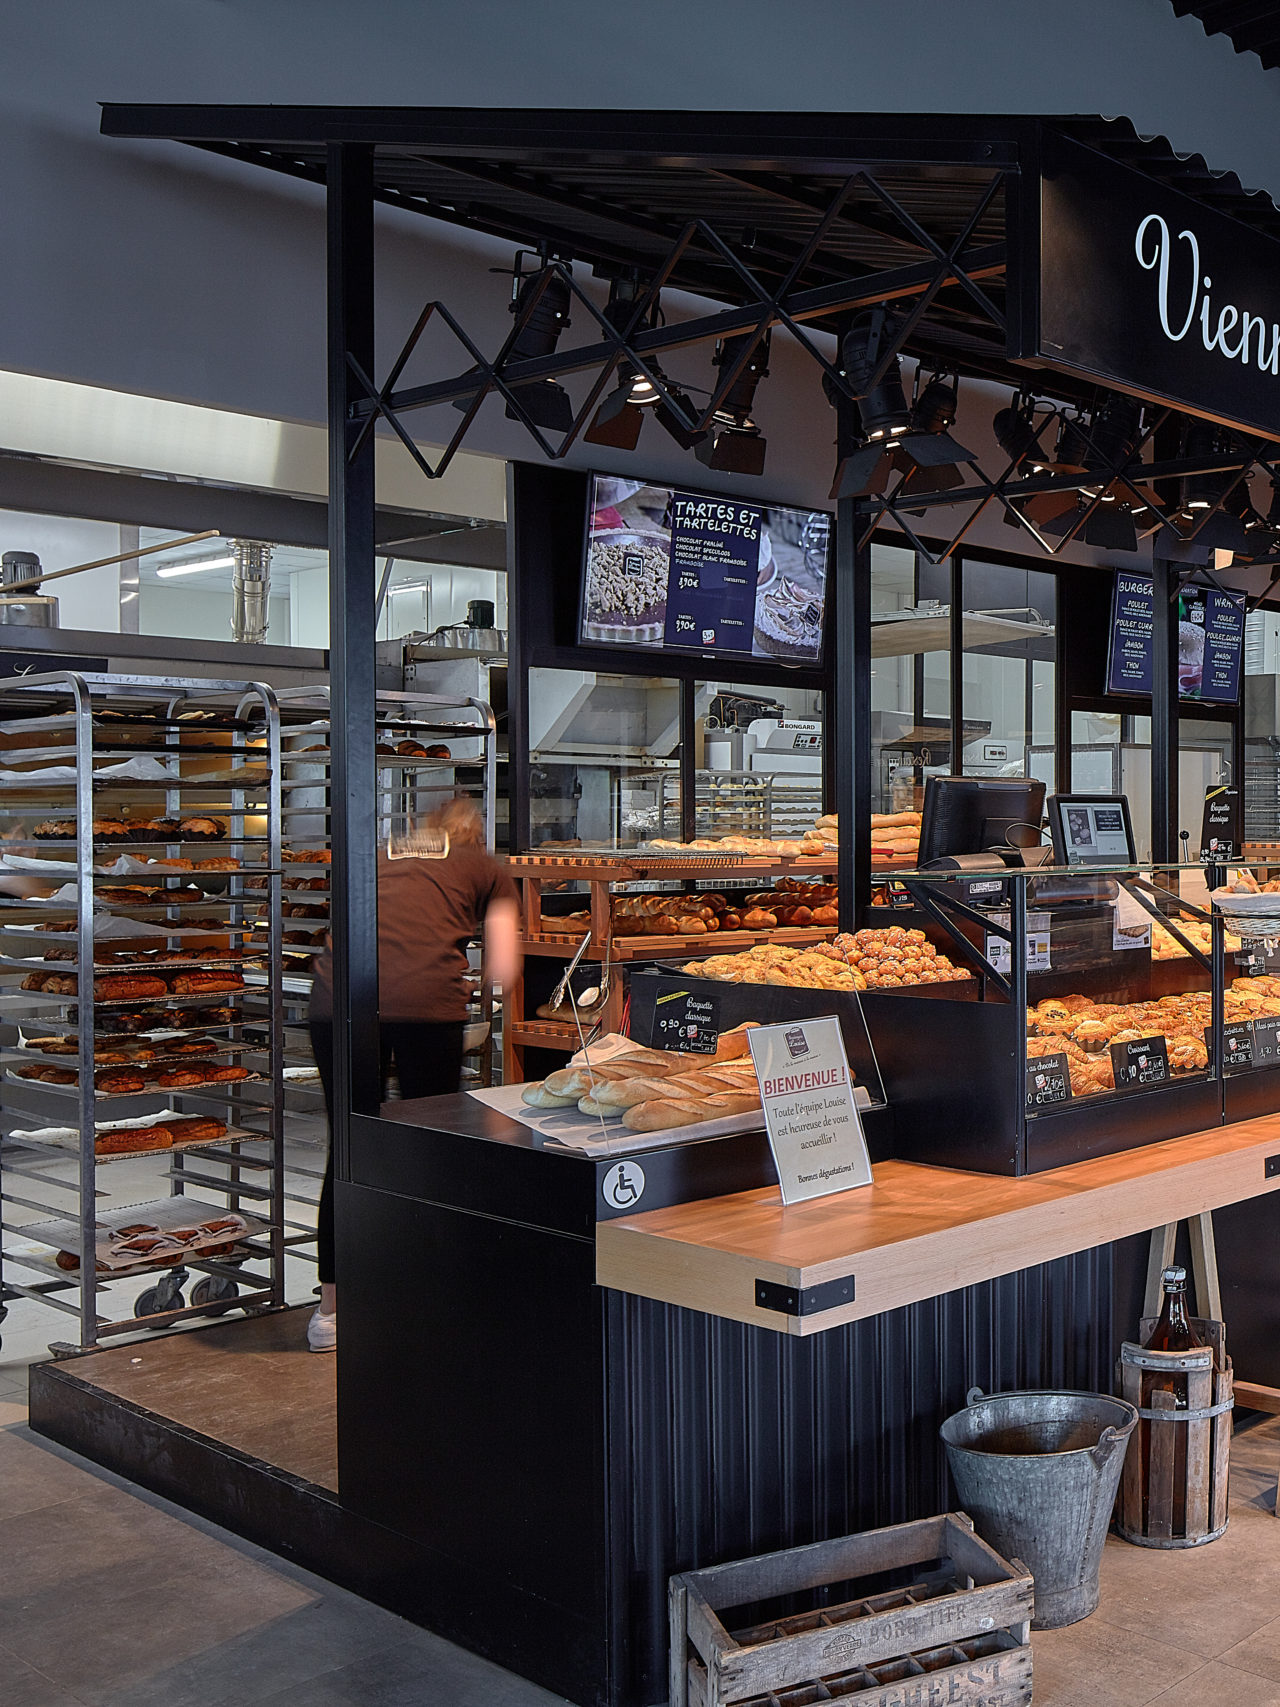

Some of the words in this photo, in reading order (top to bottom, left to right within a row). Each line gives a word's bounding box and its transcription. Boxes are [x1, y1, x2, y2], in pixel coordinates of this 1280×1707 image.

[675, 501, 735, 520] TARTES
[739, 509, 760, 526] ET
[675, 517, 757, 540] TARTELETTES
[675, 543, 702, 553] CHOCOLAT
[676, 536, 703, 545] CHOCOLAT
[674, 551, 701, 560] CHOCOLAT
[1127, 600, 1149, 610] POULET
[784, 723, 816, 731] BONGARD
[686, 996, 714, 1012] Baguette
[684, 1010, 712, 1025] classique
[659, 1018, 680, 1033] 0,90
[1127, 1043, 1151, 1055] Croissant
[1037, 1059, 1059, 1071] chocolat
[764, 1068, 838, 1096] BIENVENUE
[772, 1106, 795, 1119] Toute
[795, 1101, 823, 1117] l'équipe
[823, 1096, 847, 1109] Louise
[777, 1124, 789, 1137] est
[788, 1120, 822, 1135] heureuse
[822, 1115, 832, 1127] de
[832, 1115, 849, 1124] vous
[800, 1133, 833, 1150] accueillir
[797, 1173, 819, 1184] Bonnes
[818, 1165, 852, 1180] dégustations
